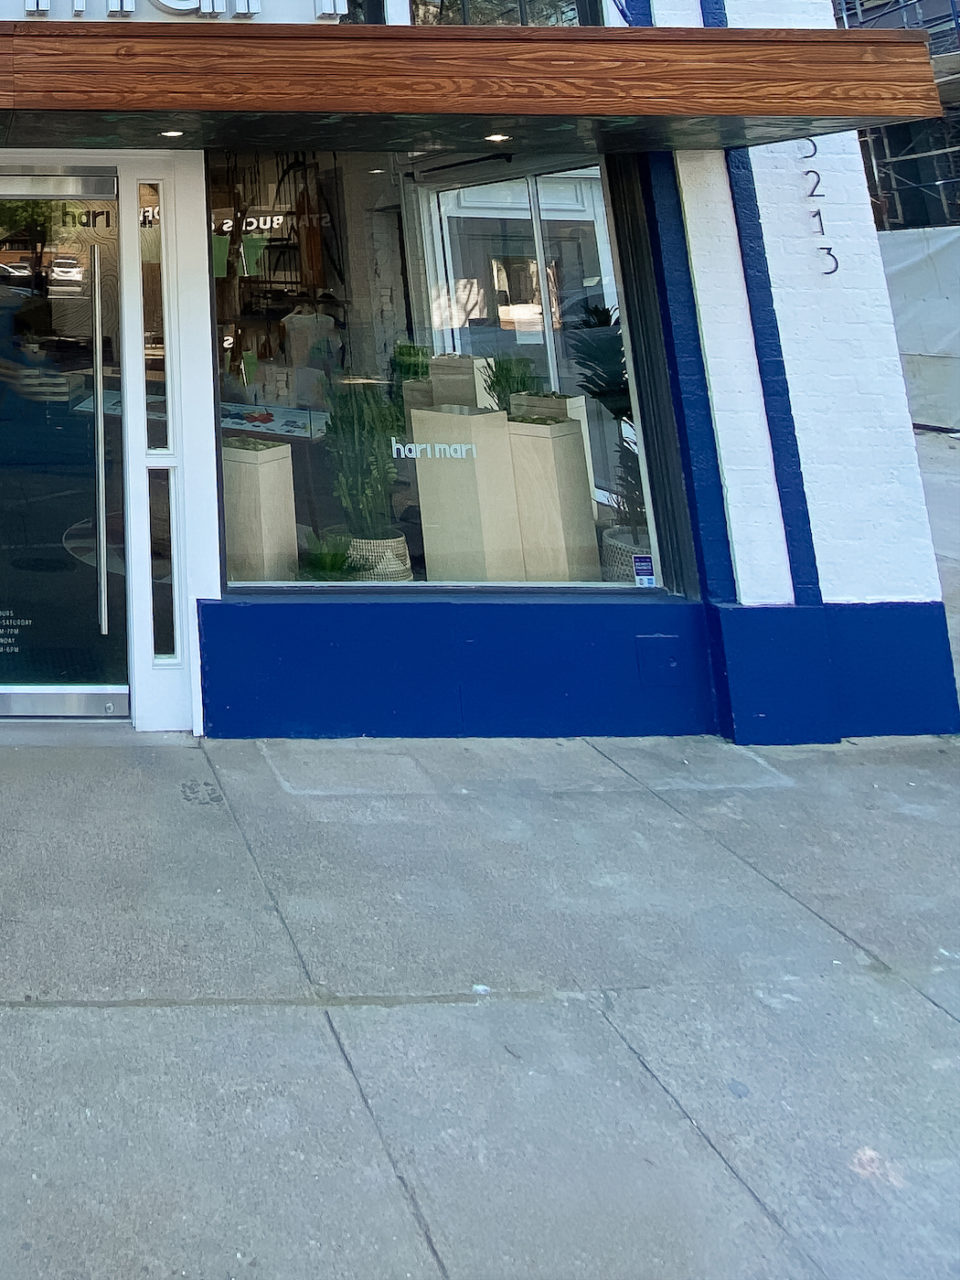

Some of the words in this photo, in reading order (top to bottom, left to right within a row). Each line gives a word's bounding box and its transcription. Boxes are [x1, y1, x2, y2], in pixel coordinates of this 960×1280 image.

[61, 202, 111, 228] hari
[390, 436, 432, 458] hari
[434, 443, 477, 458] mari
